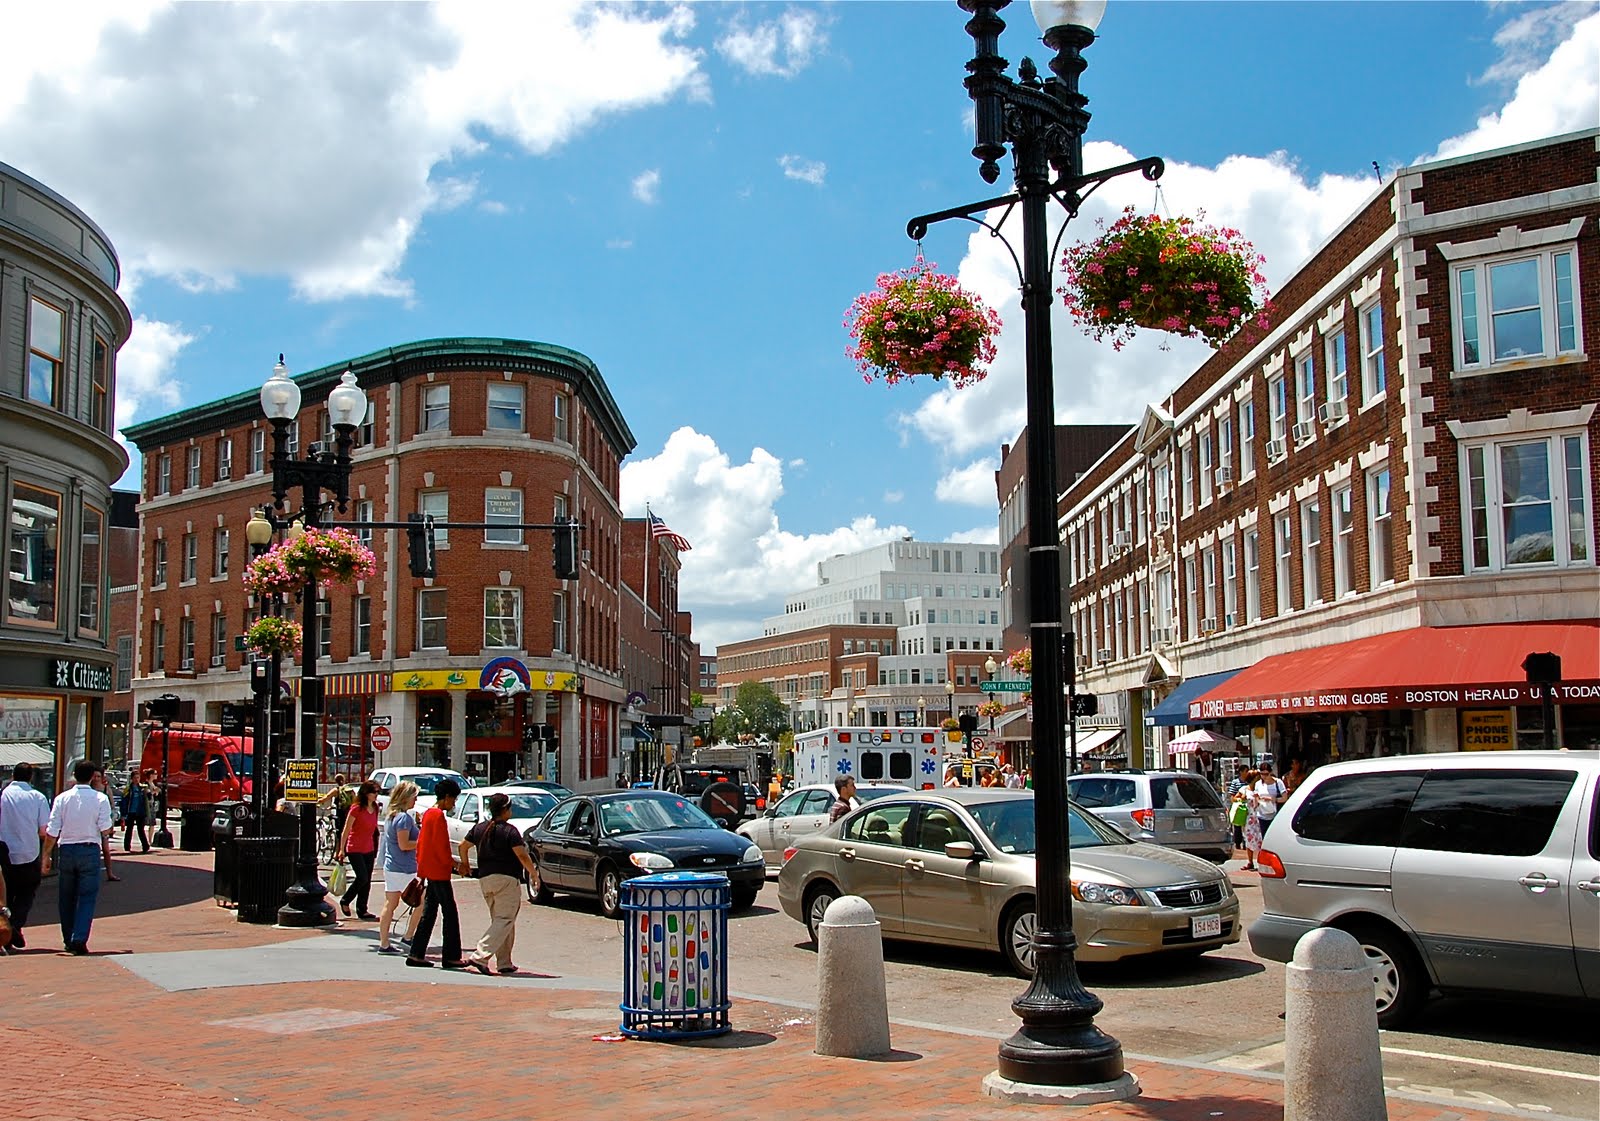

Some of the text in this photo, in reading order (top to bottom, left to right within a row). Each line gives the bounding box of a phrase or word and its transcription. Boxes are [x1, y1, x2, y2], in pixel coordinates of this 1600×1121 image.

[72, 662, 106, 690] Citizens
[982, 682, 997, 691] JOHN
[1004, 682, 1030, 691] KENNEDY
[1203, 699, 1224, 718] CORNER
[1319, 695, 1347, 706] BOSTON
[1351, 692, 1389, 705] GLOBE
[1405, 690, 1459, 703] BOSTON
[1464, 688, 1519, 702] HERALD
[1465, 725, 1509, 734] PHONE
[1466, 735, 1509, 744] CARDS
[929, 746, 938, 756] 4
[288, 762, 316, 770] Farmers
[290, 770, 314, 779] Market
[291, 780, 312, 788] AHEAD
[1194, 922, 1206, 933] 154
[1431, 943, 1497, 960] SIENNA
